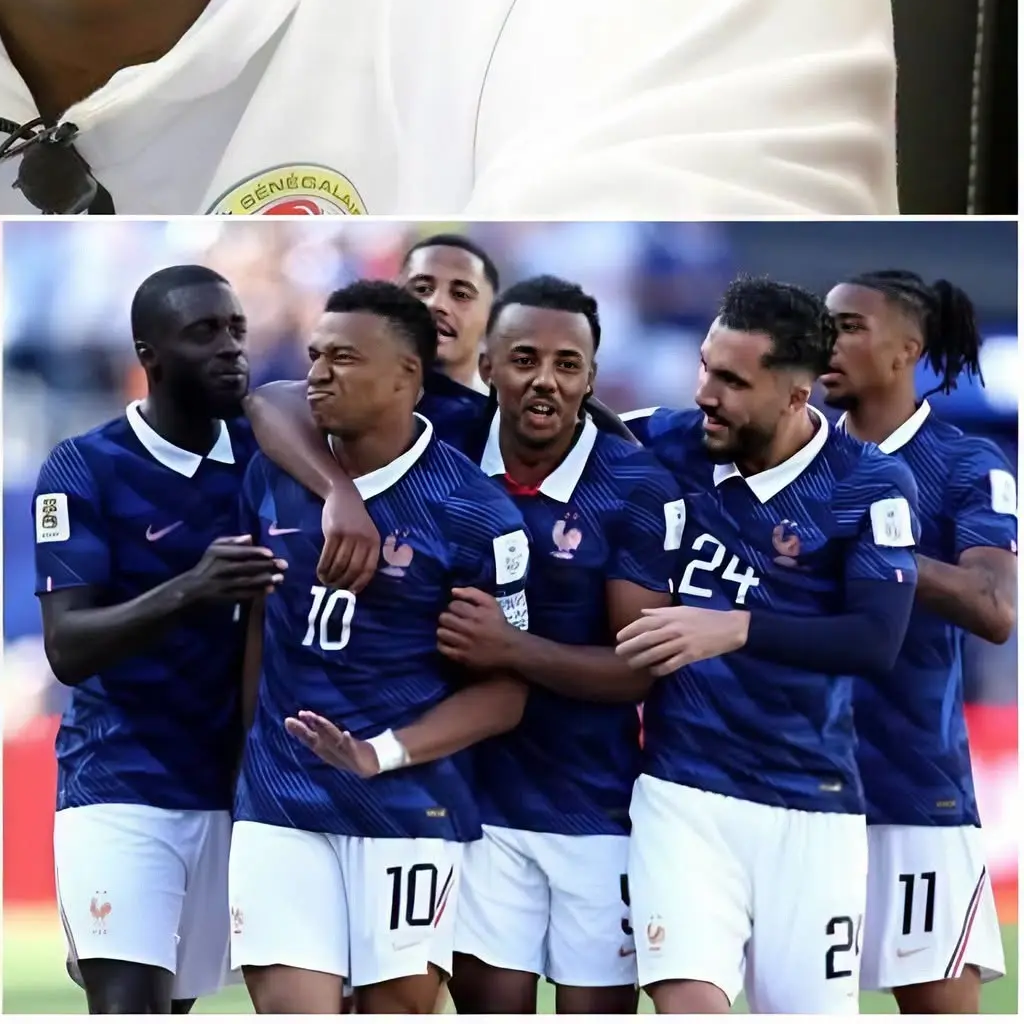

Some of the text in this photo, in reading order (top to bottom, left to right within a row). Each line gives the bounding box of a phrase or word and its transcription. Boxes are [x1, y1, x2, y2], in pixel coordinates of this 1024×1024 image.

[678, 533, 760, 604] 24
[302, 586, 356, 651] 10
[386, 863, 438, 930] 10
[899, 872, 936, 935] 11
[826, 914, 862, 980] 2
